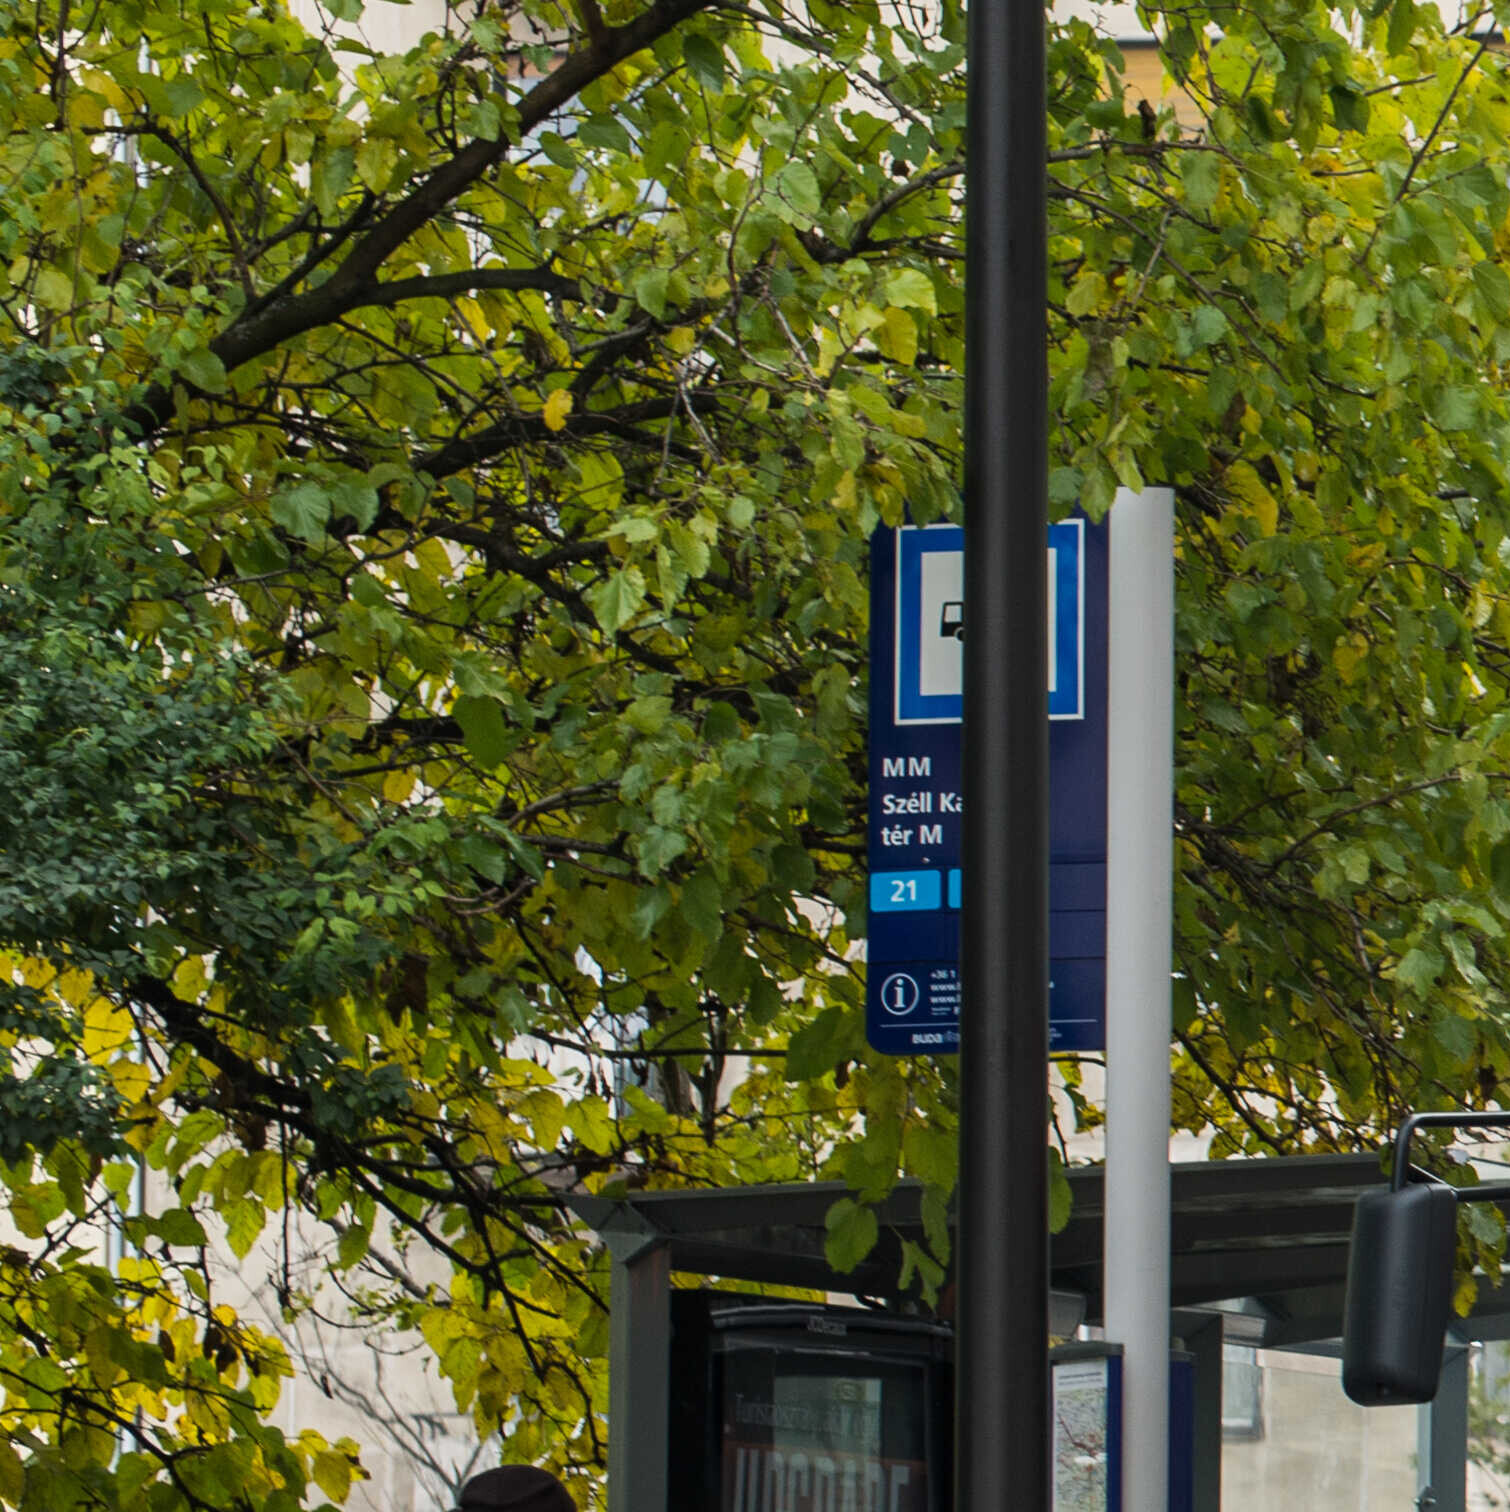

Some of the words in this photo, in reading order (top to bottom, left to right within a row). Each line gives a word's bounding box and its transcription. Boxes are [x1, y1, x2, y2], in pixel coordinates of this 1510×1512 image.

[882, 792, 932, 814] Széll
[881, 824, 913, 845] tér
[920, 824, 943, 845] M
[890, 879, 917, 902] 21
